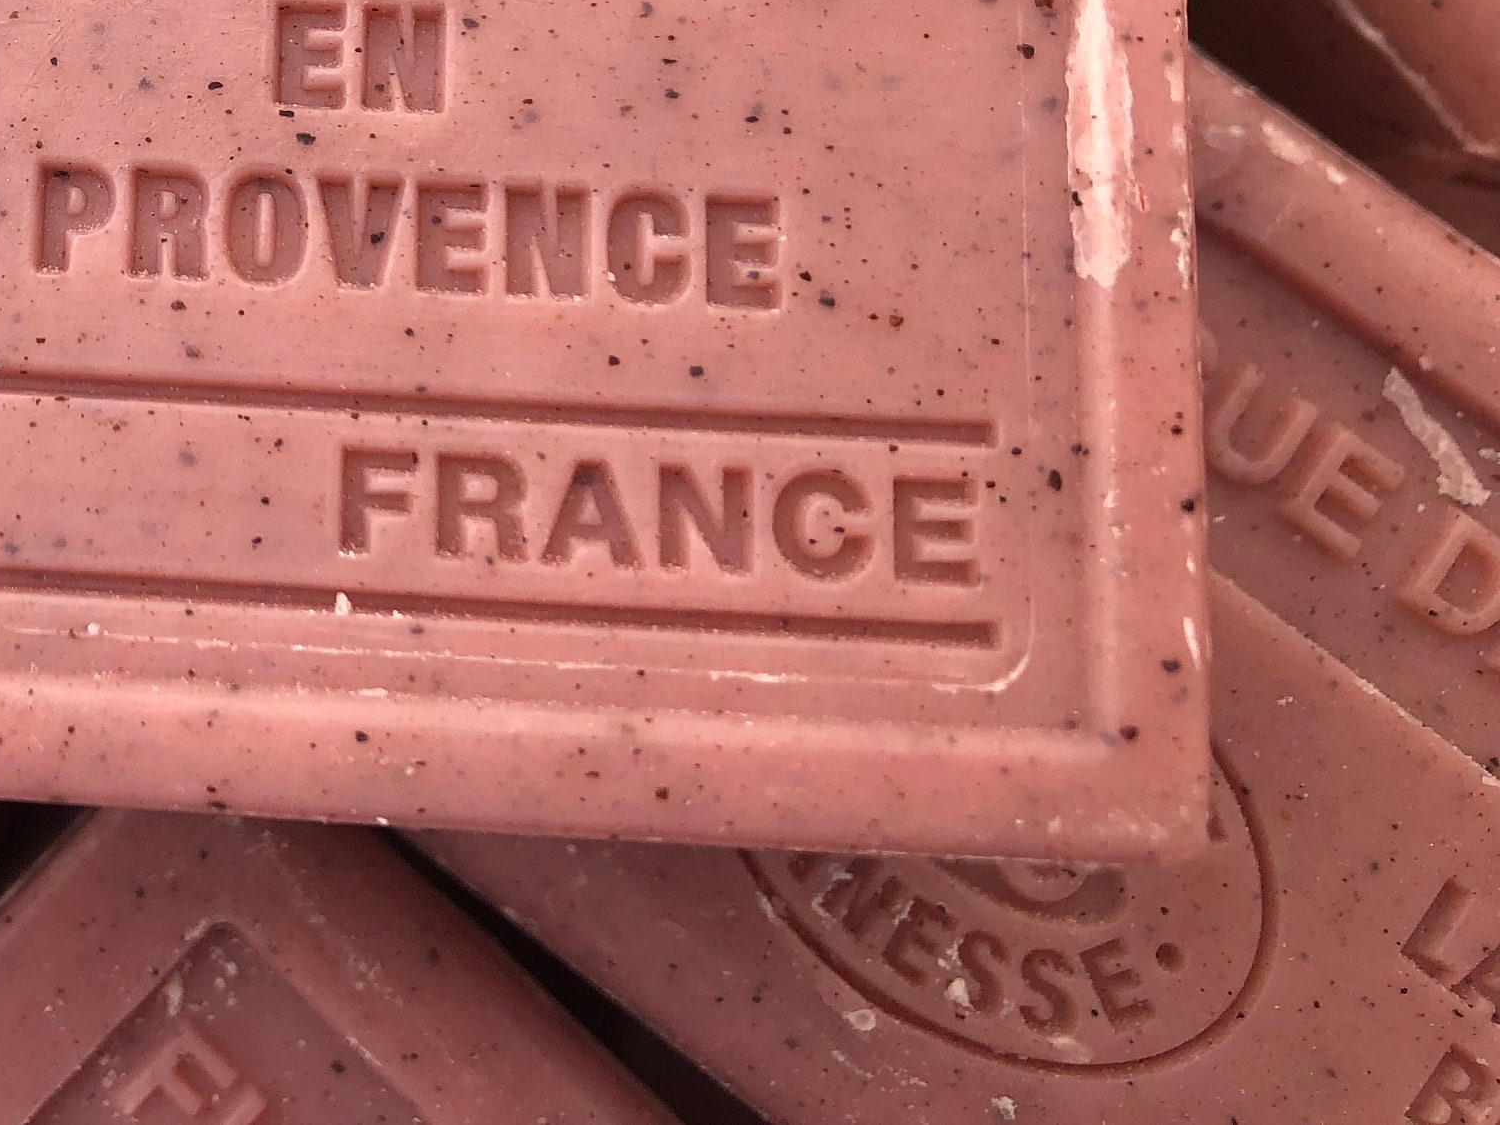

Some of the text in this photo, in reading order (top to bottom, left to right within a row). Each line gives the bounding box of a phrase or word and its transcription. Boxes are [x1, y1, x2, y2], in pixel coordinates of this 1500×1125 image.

[33, 158, 784, 311] PROVENCE
[338, 443, 982, 587] FRANCE
[788, 855, 1158, 1035] NESSE
